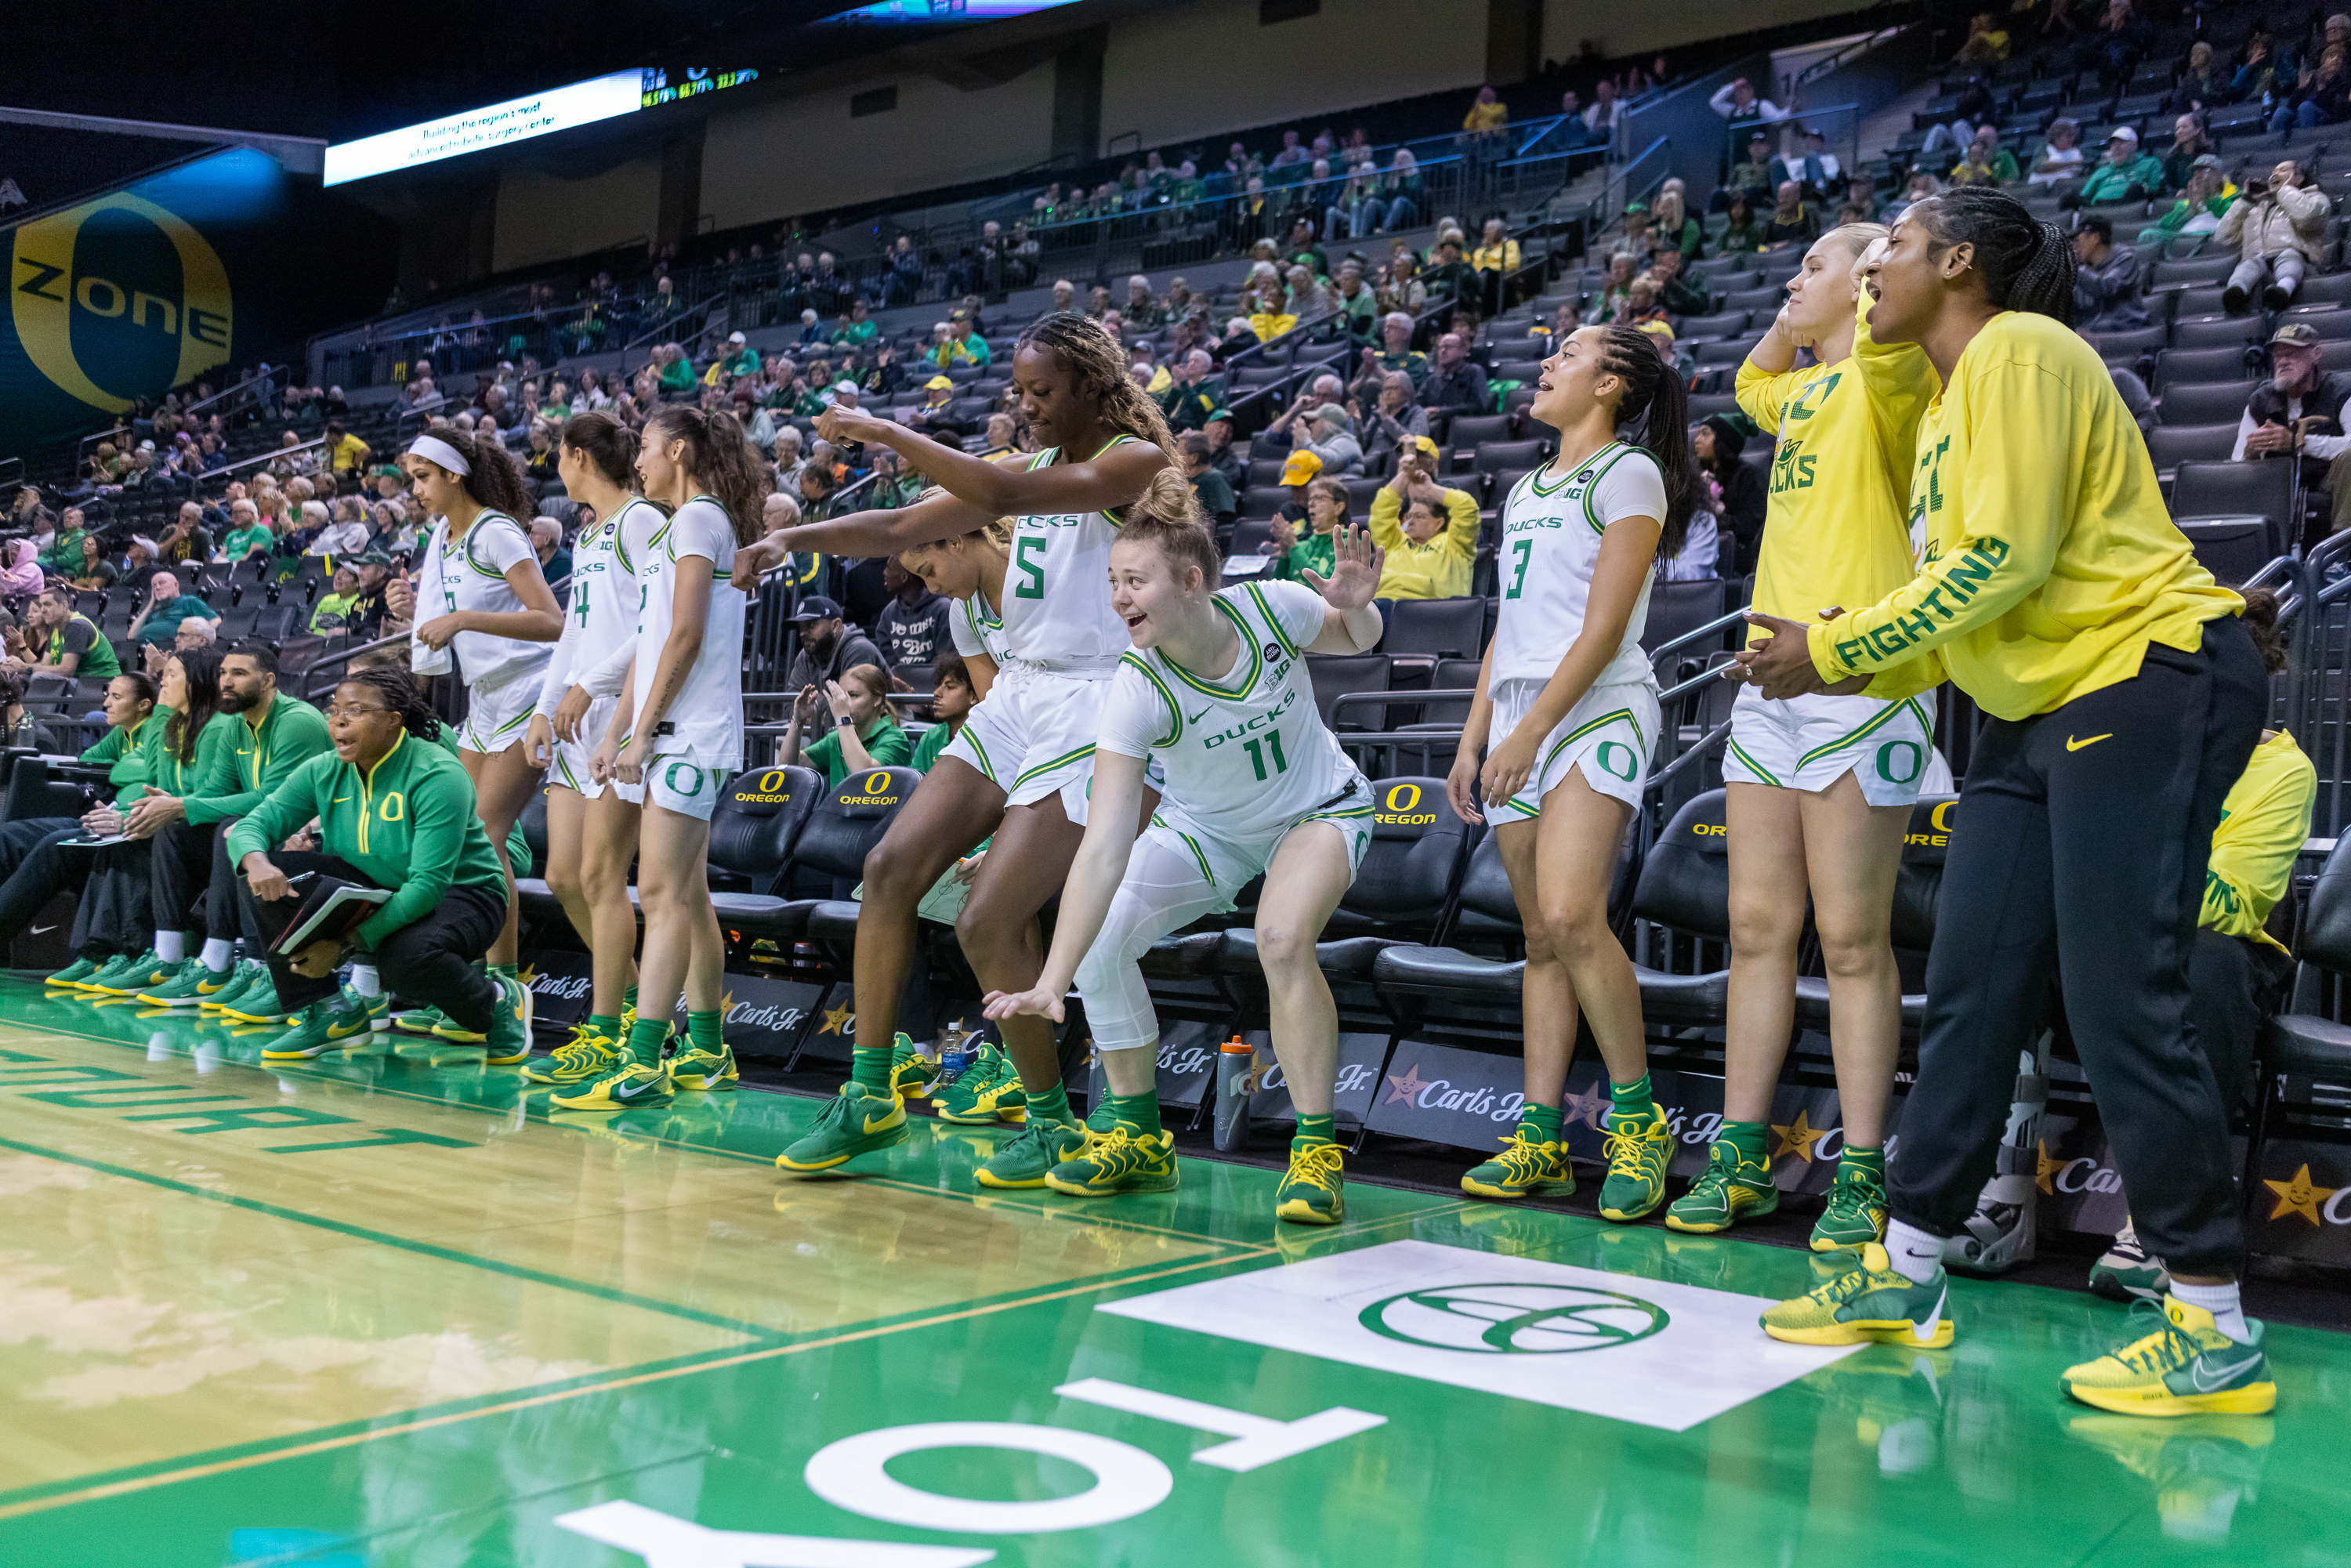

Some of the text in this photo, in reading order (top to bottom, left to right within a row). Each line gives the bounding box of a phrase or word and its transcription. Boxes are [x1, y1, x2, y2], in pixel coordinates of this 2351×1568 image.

[1770, 454, 1817, 494] CKS
[1505, 517, 1563, 535] DUCKS
[443, 575, 461, 584] CKS
[643, 563, 660, 577] CKS
[1016, 536, 1046, 599] 5
[1505, 539, 1533, 599] 3
[1835, 537, 2010, 668] FIGHTING
[1264, 659, 1291, 691] BIG
[1203, 688, 1295, 749] DUCKS
[1243, 728, 1287, 781] 11
[1375, 813, 1436, 825] REGON
[527, 972, 592, 1000] Carl's Jr.
[726, 1001, 804, 1032] Carl's Jr.
[1172, 1048, 1212, 1074] Jr.
[1335, 1064, 1372, 1094] Jr.
[1418, 1080, 1498, 1116] Carl's
